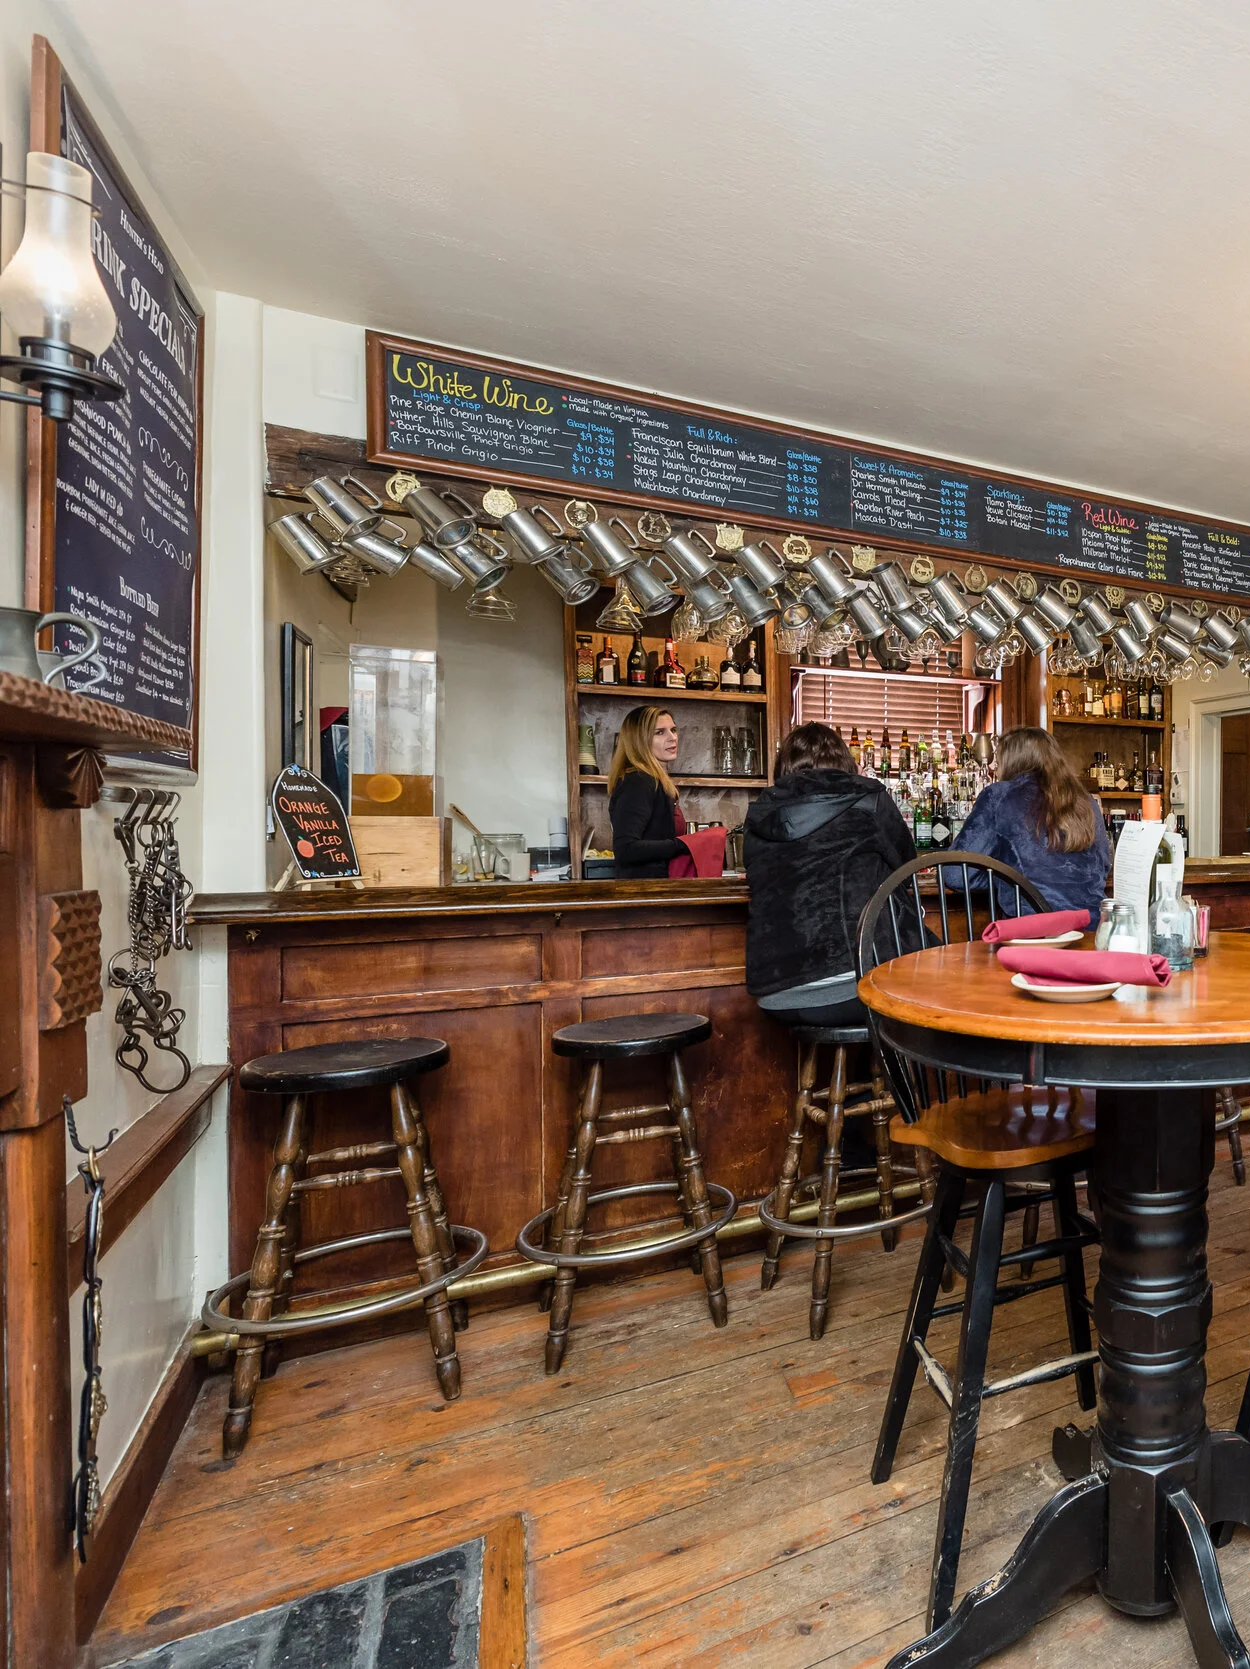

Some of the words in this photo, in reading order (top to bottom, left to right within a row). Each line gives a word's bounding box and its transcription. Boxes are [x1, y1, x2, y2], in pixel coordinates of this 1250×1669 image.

[120, 208, 147, 255] HUNTER'S
[148, 244, 164, 275] HEAD
[91, 217, 126, 299] RINK
[392, 354, 477, 399] White
[483, 376, 553, 415] Wine
[413, 389, 440, 403] Light
[443, 395, 451, 404] &
[454, 398, 484, 411] Crisp:
[390, 395, 412, 408] Pine
[416, 401, 445, 416] Ridge
[450, 407, 482, 422] Chenin
[516, 418, 560, 436] Viognier
[568, 404, 590, 413] Made
[593, 409, 607, 417] with
[610, 412, 634, 423] Organic
[636, 417, 669, 429] Ingredients
[623, 406, 649, 417] Virginia
[390, 409, 425, 422] Wither
[433, 416, 454, 429] Hills
[462, 421, 516, 441] Sauvignon
[567, 418, 614, 435] Glass/Bottle
[686, 425, 705, 439] Full
[390, 431, 420, 445] Riff
[425, 438, 456, 452] Pinot
[462, 445, 498, 461] Grigio
[396, 420, 467, 441] Barboursville
[472, 434, 500, 447] Pinot
[503, 442, 533, 455] Grigio
[631, 428, 683, 449] Franciscan
[737, 450, 757, 463] White
[758, 455, 777, 467] Blend
[633, 442, 660, 456] Santa
[663, 448, 685, 460] Julia
[690, 453, 737, 472] Chardonnay
[853, 456, 878, 471] Sweet
[633, 453, 658, 466] Naked
[662, 460, 697, 475] Mountain
[700, 467, 747, 487] Chardonnay
[633, 465, 658, 481] Stags
[662, 472, 681, 486] Leap
[684, 475, 731, 493] Chardonnay
[851, 469, 876, 483] Charles
[878, 475, 899, 486] Smith
[900, 478, 927, 491] Moscato
[85, 476, 99, 498] LADY
[100, 485, 106, 502] IN
[633, 478, 679, 495] Matchbook
[682, 486, 726, 506] Chardonnay
[851, 478, 865, 489] Dr.
[894, 487, 923, 502] Riesling
[853, 500, 884, 515] Rapidan
[885, 506, 904, 518] River
[906, 510, 925, 522] Peach
[1006, 499, 1034, 513] Prosecco
[1006, 509, 1034, 523] Clicquot
[1081, 501, 1107, 528] Red
[1108, 509, 1139, 530] Wine
[855, 512, 886, 526] Moscato
[1105, 532, 1119, 543] Pinot
[1121, 537, 1133, 545] Noir
[1105, 541, 1119, 552] Pinot
[1121, 545, 1133, 553] Noir
[1182, 540, 1202, 550] Ancient
[1207, 532, 1220, 543] Full
[1110, 552, 1131, 564] Merlot
[1182, 550, 1197, 559] Santa
[1214, 555, 1232, 566] Malbec
[1128, 566, 1144, 579] Franc
[1185, 578, 1200, 588] Three
[1201, 580, 1211, 590] Fox
[1212, 581, 1229, 592] Merlot
[70, 585, 84, 604] Napa
[86, 592, 100, 608] Smith
[100, 601, 118, 616] Organic
[119, 575, 146, 609] BOTTLED
[146, 592, 159, 618] BEER
[110, 622, 126, 639] Ginger
[102, 636, 116, 650] Cider
[279, 796, 330, 815] ORANGE
[293, 815, 339, 833] VANILLA
[311, 832, 342, 847] ICED
[322, 848, 349, 862] TEA
